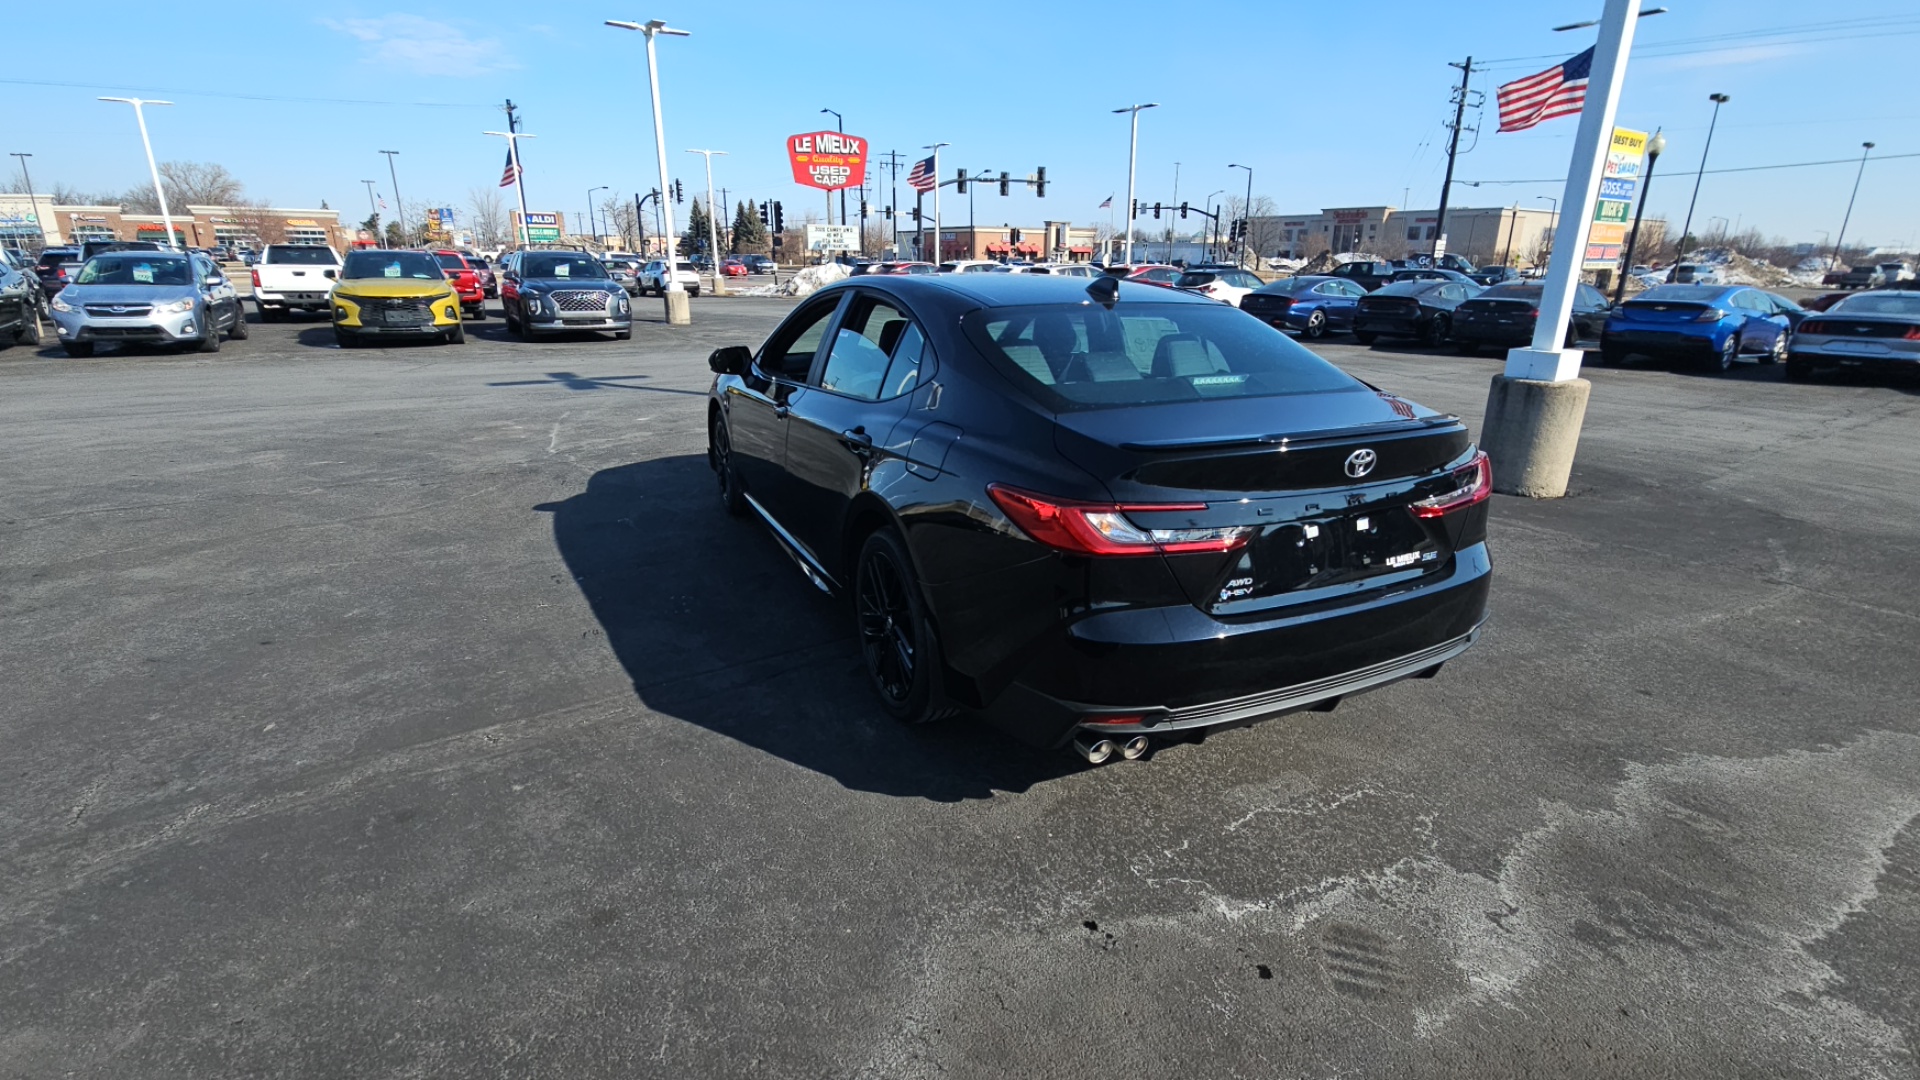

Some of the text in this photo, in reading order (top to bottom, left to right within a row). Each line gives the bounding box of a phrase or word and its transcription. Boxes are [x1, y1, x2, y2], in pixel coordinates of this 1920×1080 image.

[794, 134, 860, 154] LE MIEUX
[1613, 135, 1643, 148] BEST BUY
[812, 154, 844, 165] Quality
[809, 165, 851, 176] USED
[814, 175, 847, 186] CARS
[1601, 181, 1622, 195] ROSS
[532, 215, 556, 224] ALDI
[1418, 255, 1444, 266] Gek
[1386, 556, 1396, 566] LE
[1396, 550, 1420, 563] MIEUX
[1422, 550, 1438, 562] SE
[1226, 577, 1254, 588] AWD
[1227, 586, 1254, 597] HEV
